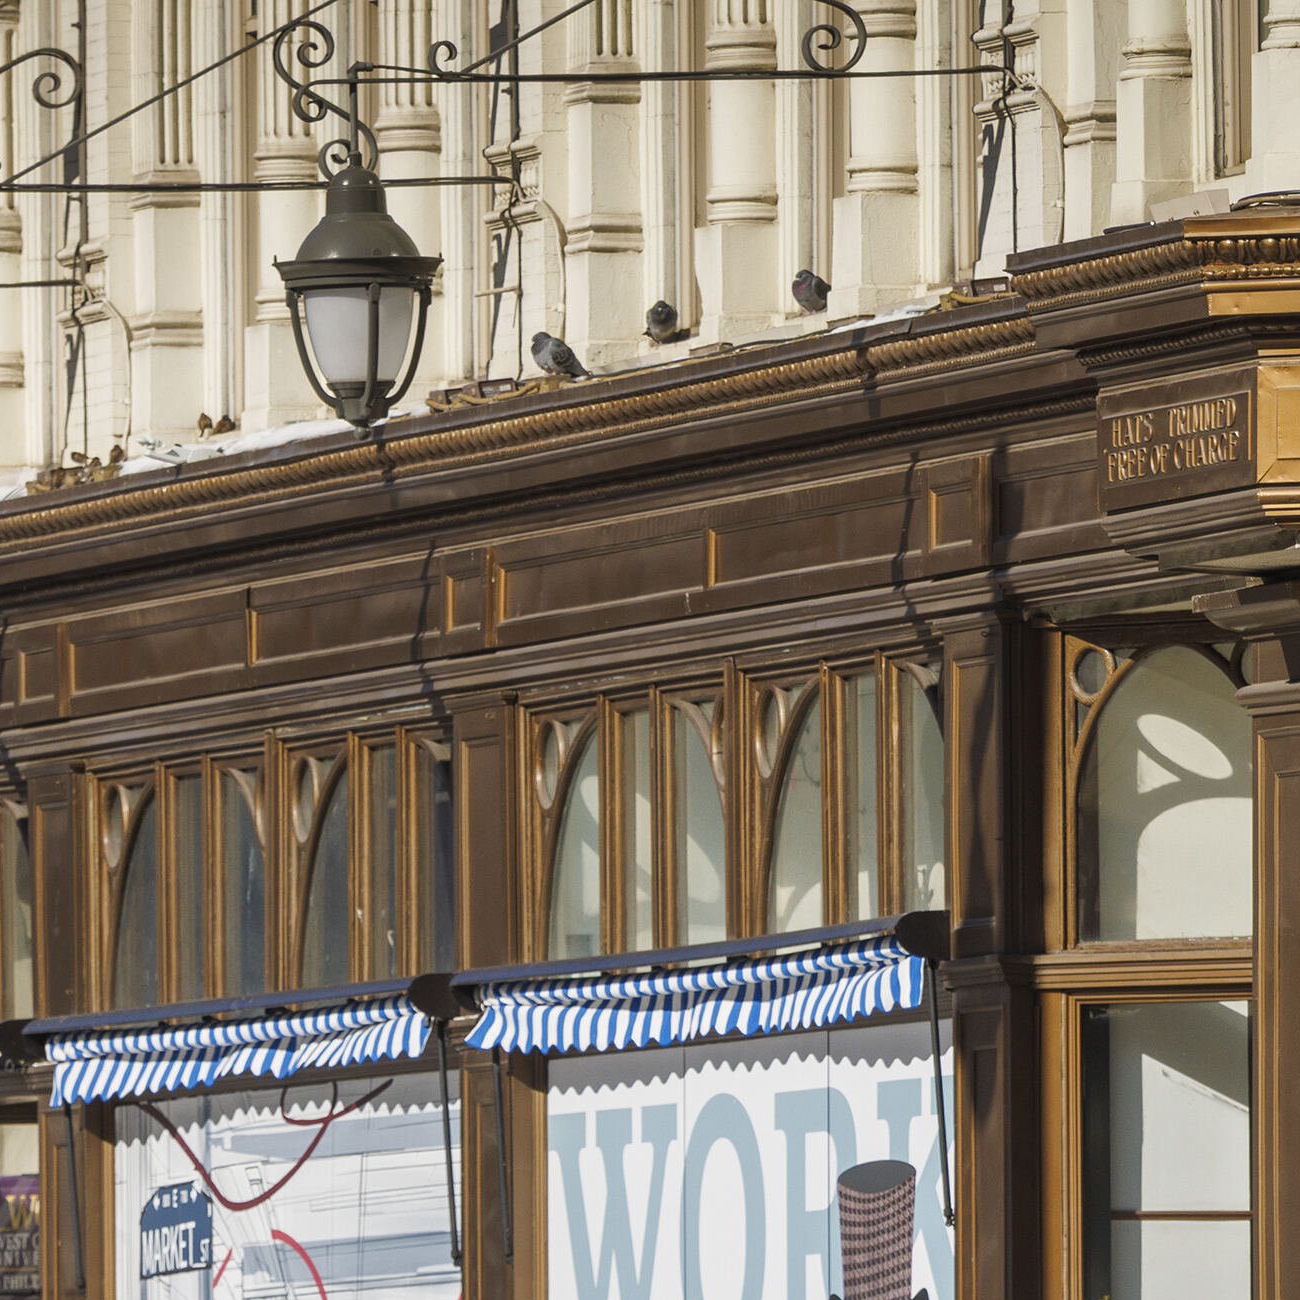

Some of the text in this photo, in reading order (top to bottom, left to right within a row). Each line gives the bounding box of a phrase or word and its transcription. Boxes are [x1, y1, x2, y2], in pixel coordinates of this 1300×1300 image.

[1111, 398, 1237, 448] HATS TRIMMED
[1107, 430, 1240, 483] FREE OF CHARGE
[142, 1221, 210, 1277] MARKET ST
